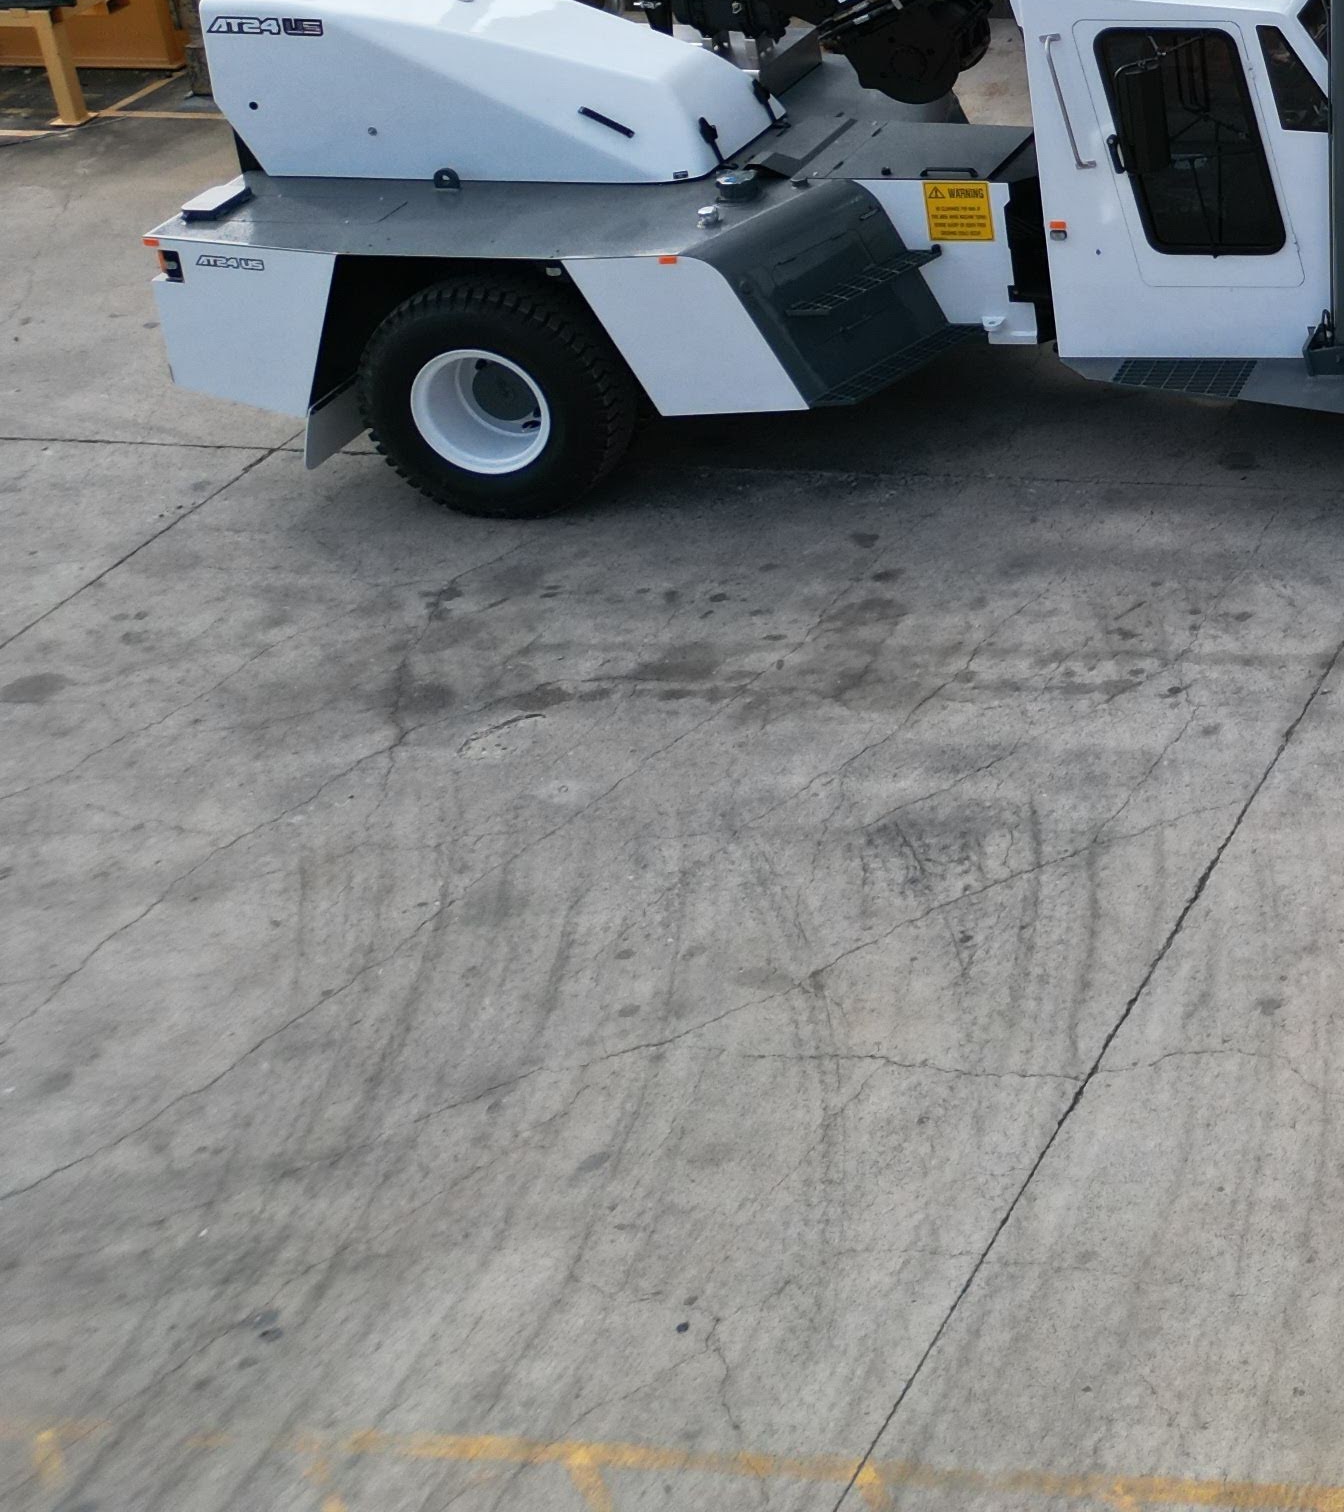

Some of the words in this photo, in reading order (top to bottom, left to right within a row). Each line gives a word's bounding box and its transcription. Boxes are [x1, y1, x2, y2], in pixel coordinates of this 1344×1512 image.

[207, 15, 281, 36] AT24
[948, 187, 985, 199] WARNING
[196, 254, 240, 269] AT24
[239, 258, 265, 271] US
